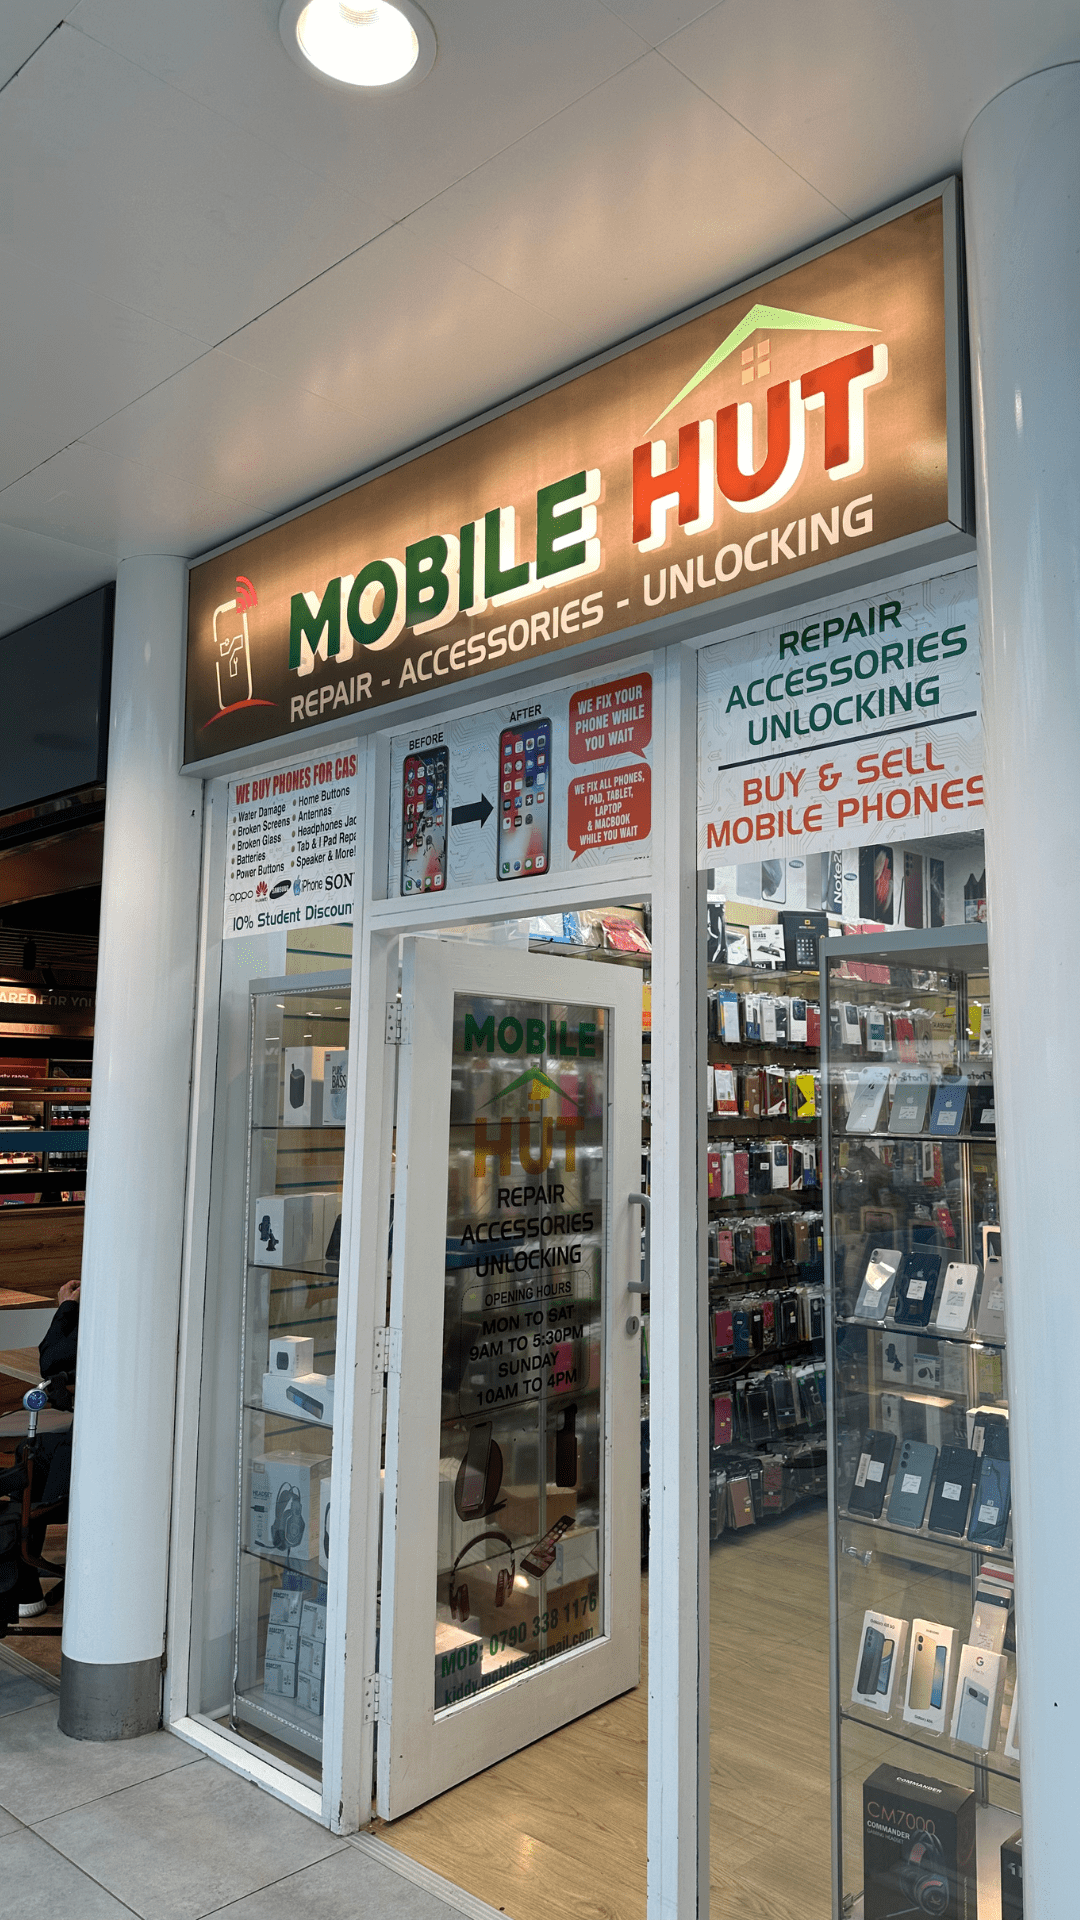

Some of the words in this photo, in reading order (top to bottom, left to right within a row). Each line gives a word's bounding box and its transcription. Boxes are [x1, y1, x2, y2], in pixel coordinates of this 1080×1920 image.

[289, 469, 597, 675] MOBILE
[632, 343, 884, 550] HUT
[290, 672, 373, 723] REPAIR
[381, 680, 391, 688] -
[398, 590, 605, 688] ACCESSORIES
[617, 600, 630, 610] -
[642, 494, 875, 608] UNLOCKING
[779, 600, 903, 660] REPAIR
[725, 624, 968, 713] ACCESSORIES
[577, 698, 593, 715] WE
[595, 693, 613, 711] FIX
[614, 685, 643, 706] YOUR
[748, 675, 940, 746] UNLOCKING
[509, 704, 542, 723] AFTER
[575, 713, 609, 735] PHONE
[611, 704, 645, 727] WHILE
[409, 731, 445, 750] BEFORE
[585, 733, 607, 752] YOU
[608, 727, 634, 746] WAIT
[236, 783, 250, 805] WE
[252, 777, 271, 801] BUY
[273, 766, 311, 796] PHONES
[313, 760, 332, 786] FOR
[335, 754, 358, 781] CAS
[574, 783, 586, 795] WE
[586, 780, 599, 792] FIX
[599, 777, 612, 790] ALL
[613, 770, 645, 787] PHONES,
[743, 768, 806, 807] BUY
[818, 763, 843, 792] &
[857, 742, 945, 786] SELL
[298, 794, 319, 807] Home
[321, 786, 350, 801] Buttons
[588, 792, 604, 806] PAD,
[606, 786, 634, 803] TABLET,
[238, 811, 257, 823] Water
[258, 803, 286, 819] Damage
[298, 806, 332, 822] Antennas
[595, 802, 622, 817] LAPTOP
[706, 804, 823, 849] MOBILE
[837, 774, 984, 828] PHONES
[237, 823, 262, 837] Broken
[263, 816, 290, 832] Screens
[297, 819, 343, 838] Headphones
[587, 820, 594, 832] &
[594, 813, 631, 831] MACBOOK
[237, 838, 261, 851] Broken
[262, 833, 282, 846] Glass
[297, 840, 310, 852] Tab
[312, 838, 317, 849] &
[323, 834, 337, 847] Pad
[579, 832, 602, 846] WHILE
[603, 829, 618, 843] YOU
[619, 825, 638, 840] WAIT
[236, 851, 266, 866] Batteries
[296, 852, 326, 870] Speaker
[328, 850, 333, 861] &
[335, 845, 356, 860] More!
[236, 867, 257, 880] Power
[258, 862, 284, 877] Buttons
[229, 890, 253, 903] oppo
[301, 879, 323, 892] iPhone
[325, 872, 355, 891] SON
[233, 915, 254, 931] 10%
[258, 908, 301, 928] Student
[305, 902, 355, 921] Discoun
[40, 994, 67, 1006] FOR
[464, 1014, 596, 1057] MOBILE
[332, 1066, 343, 1075] PURE
[332, 1075, 347, 1088] BASS
[474, 1116, 585, 1178] HUT
[497, 1184, 565, 1209] REPAIR
[460, 1212, 594, 1246] ACCESSORIES
[475, 1244, 582, 1278] UNLOCKING
[485, 1287, 533, 1307] OPENING
[536, 1281, 572, 1299] HOURS
[482, 1315, 520, 1335] MON
[524, 1310, 544, 1327] TO
[548, 1305, 575, 1323] SAT
[469, 1341, 503, 1361] 9AM
[508, 1335, 528, 1353] TO
[533, 1324, 584, 1347] 5:30PM
[498, 1351, 559, 1378] SUNDAY
[477, 1383, 518, 1406] 10AM
[523, 1377, 543, 1395] TO
[547, 1369, 577, 1388] 4PM
[441, 1642, 483, 1678] MOB:
[489, 1621, 527, 1656] 0790
[532, 1608, 559, 1637] 338
[563, 1591, 597, 1623] 1176
[896, 1777, 943, 1794] COMMANDER
[867, 1801, 936, 1836] CM7000
[867, 1820, 910, 1840] COMMANDER
